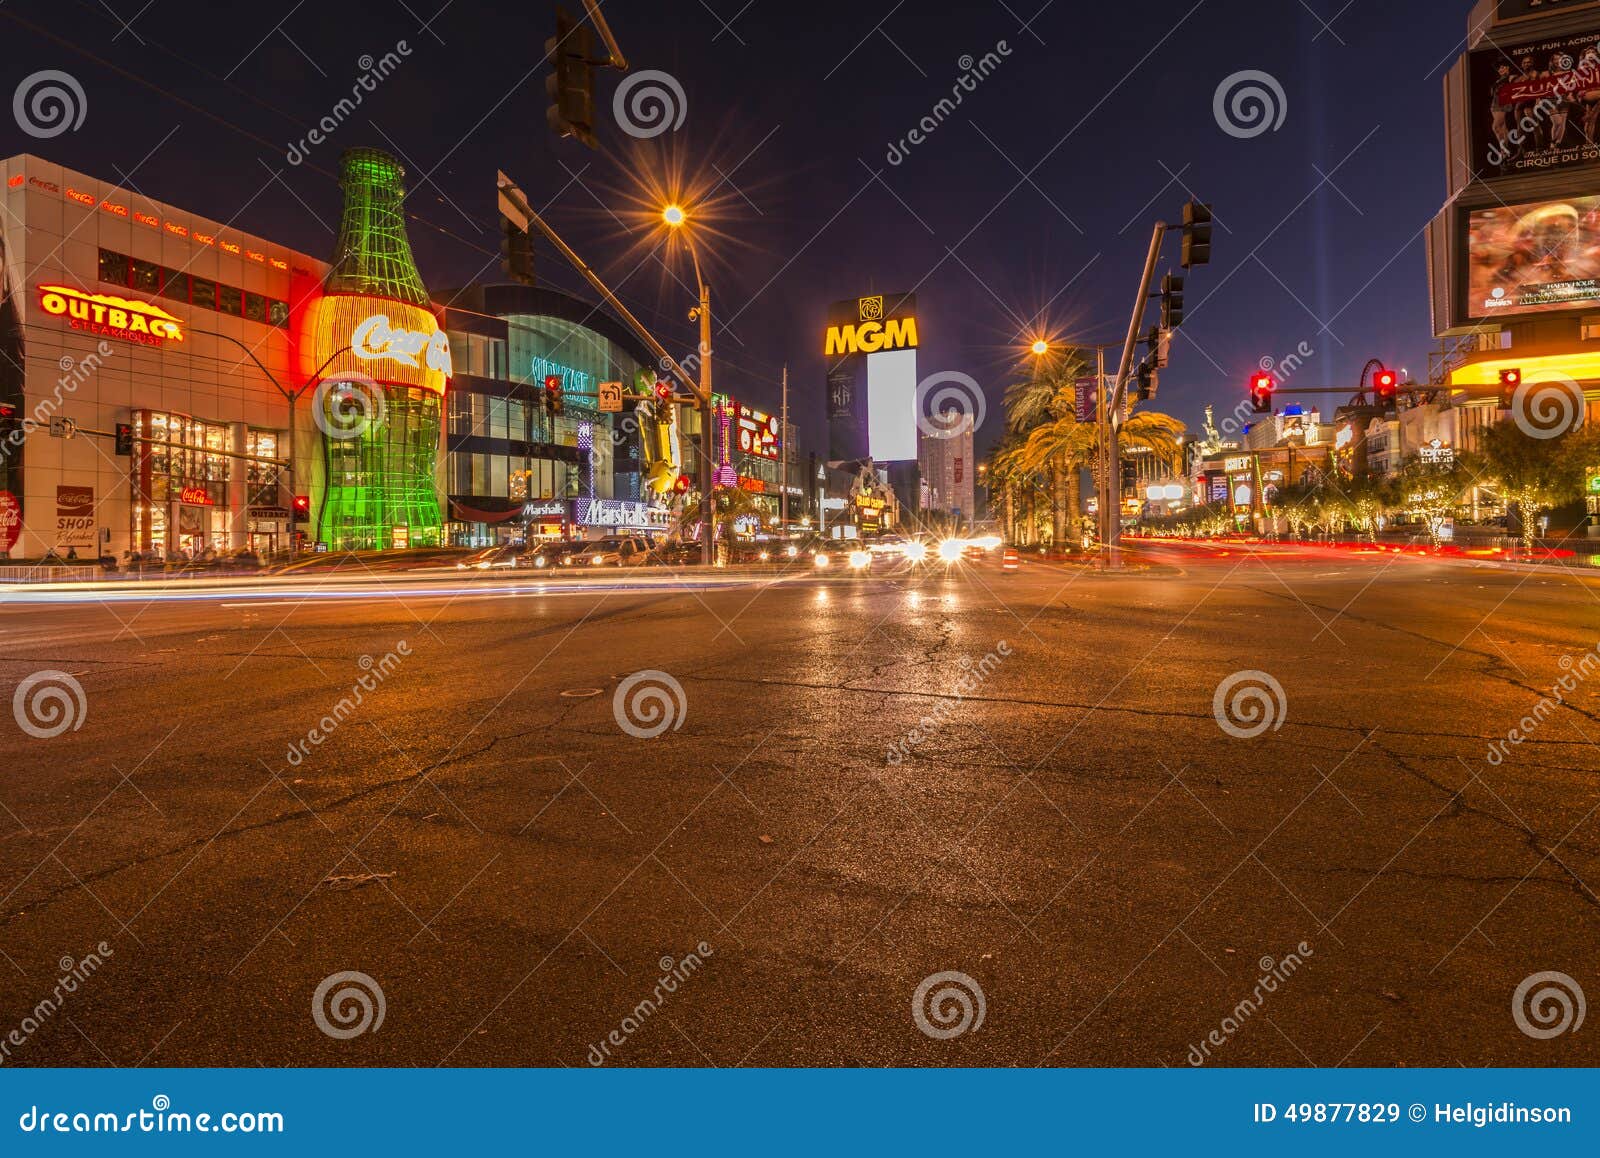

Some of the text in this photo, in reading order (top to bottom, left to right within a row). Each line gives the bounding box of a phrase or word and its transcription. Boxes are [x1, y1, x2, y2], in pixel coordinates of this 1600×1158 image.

[1512, 46, 1535, 56] SEXY
[1542, 42, 1560, 51] FUN
[1515, 156, 1558, 168] CIRQUE
[1562, 153, 1579, 162] DU
[42, 293, 184, 342] OUTBACK
[70, 319, 162, 347] STEAKHOUSE
[825, 317, 918, 355] MGM
[523, 503, 565, 515] Marshalls
[583, 499, 649, 527] Marshalls
[57, 518, 94, 530] SHOP
